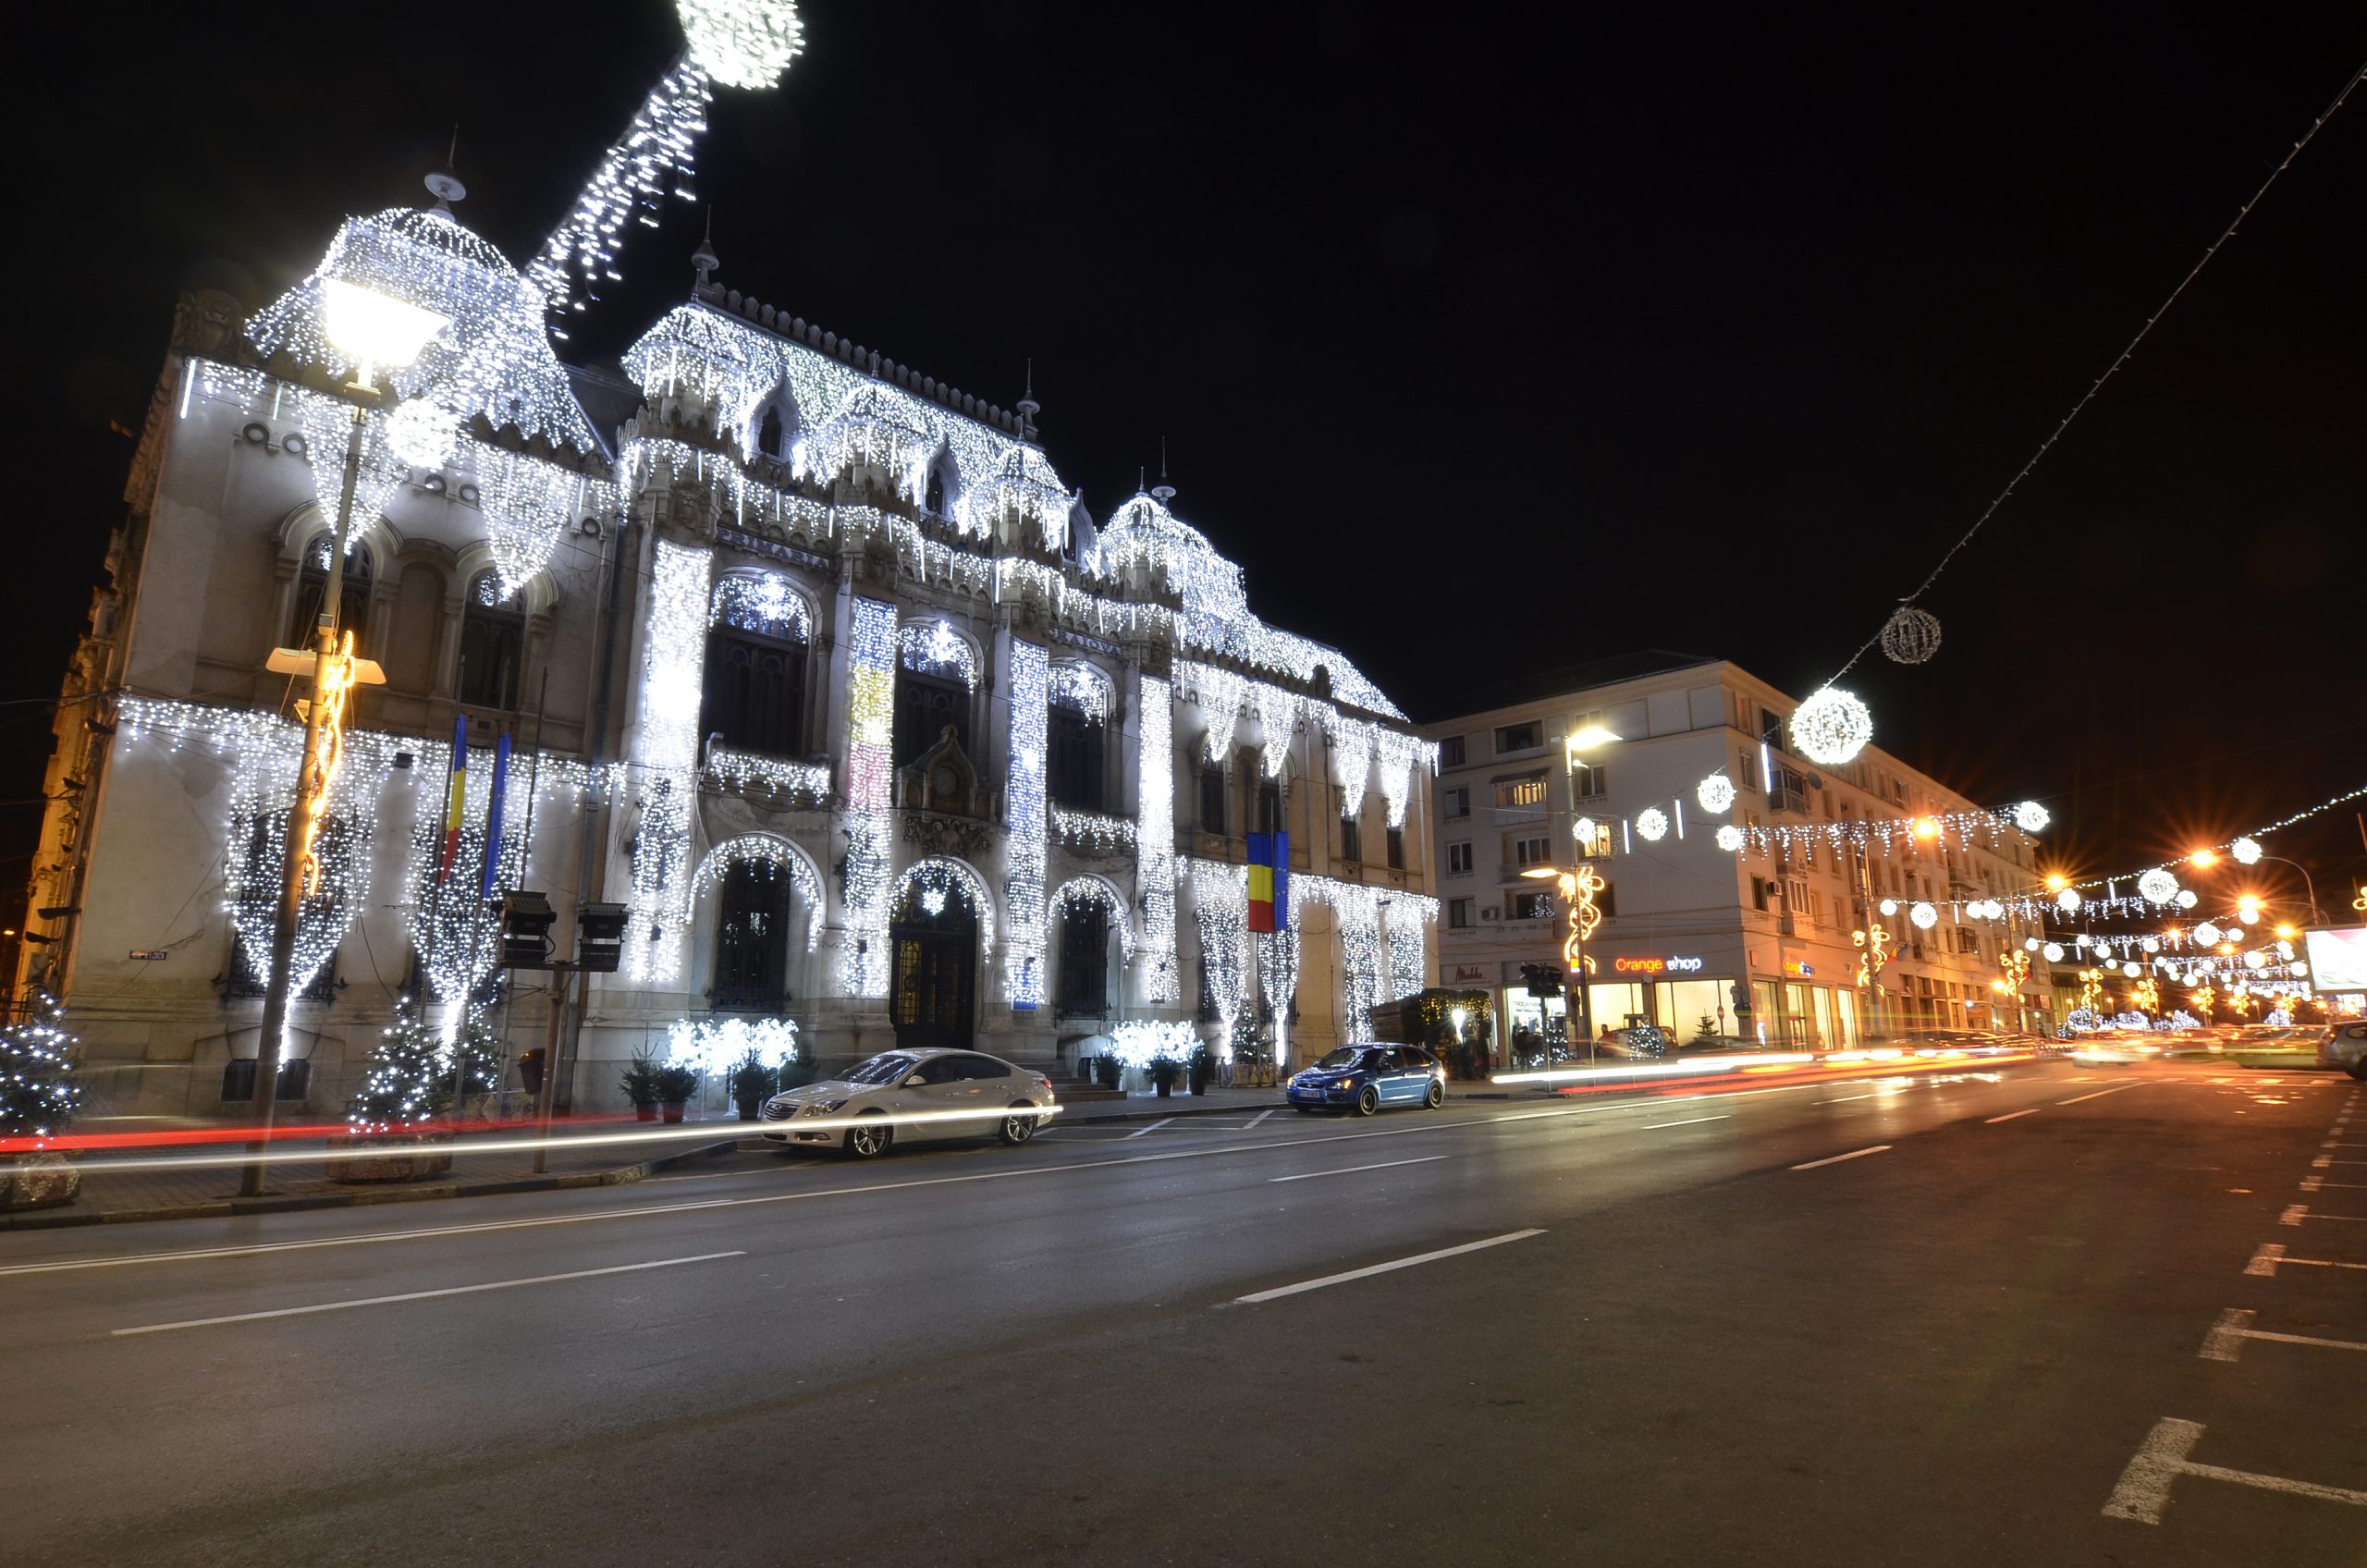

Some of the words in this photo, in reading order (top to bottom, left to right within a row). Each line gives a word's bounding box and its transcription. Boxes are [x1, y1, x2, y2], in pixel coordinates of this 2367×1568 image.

[1049, 628, 1122, 655] CRAIOVA
[1615, 958, 1663, 974] Orange
[1666, 956, 1702, 973] shop
